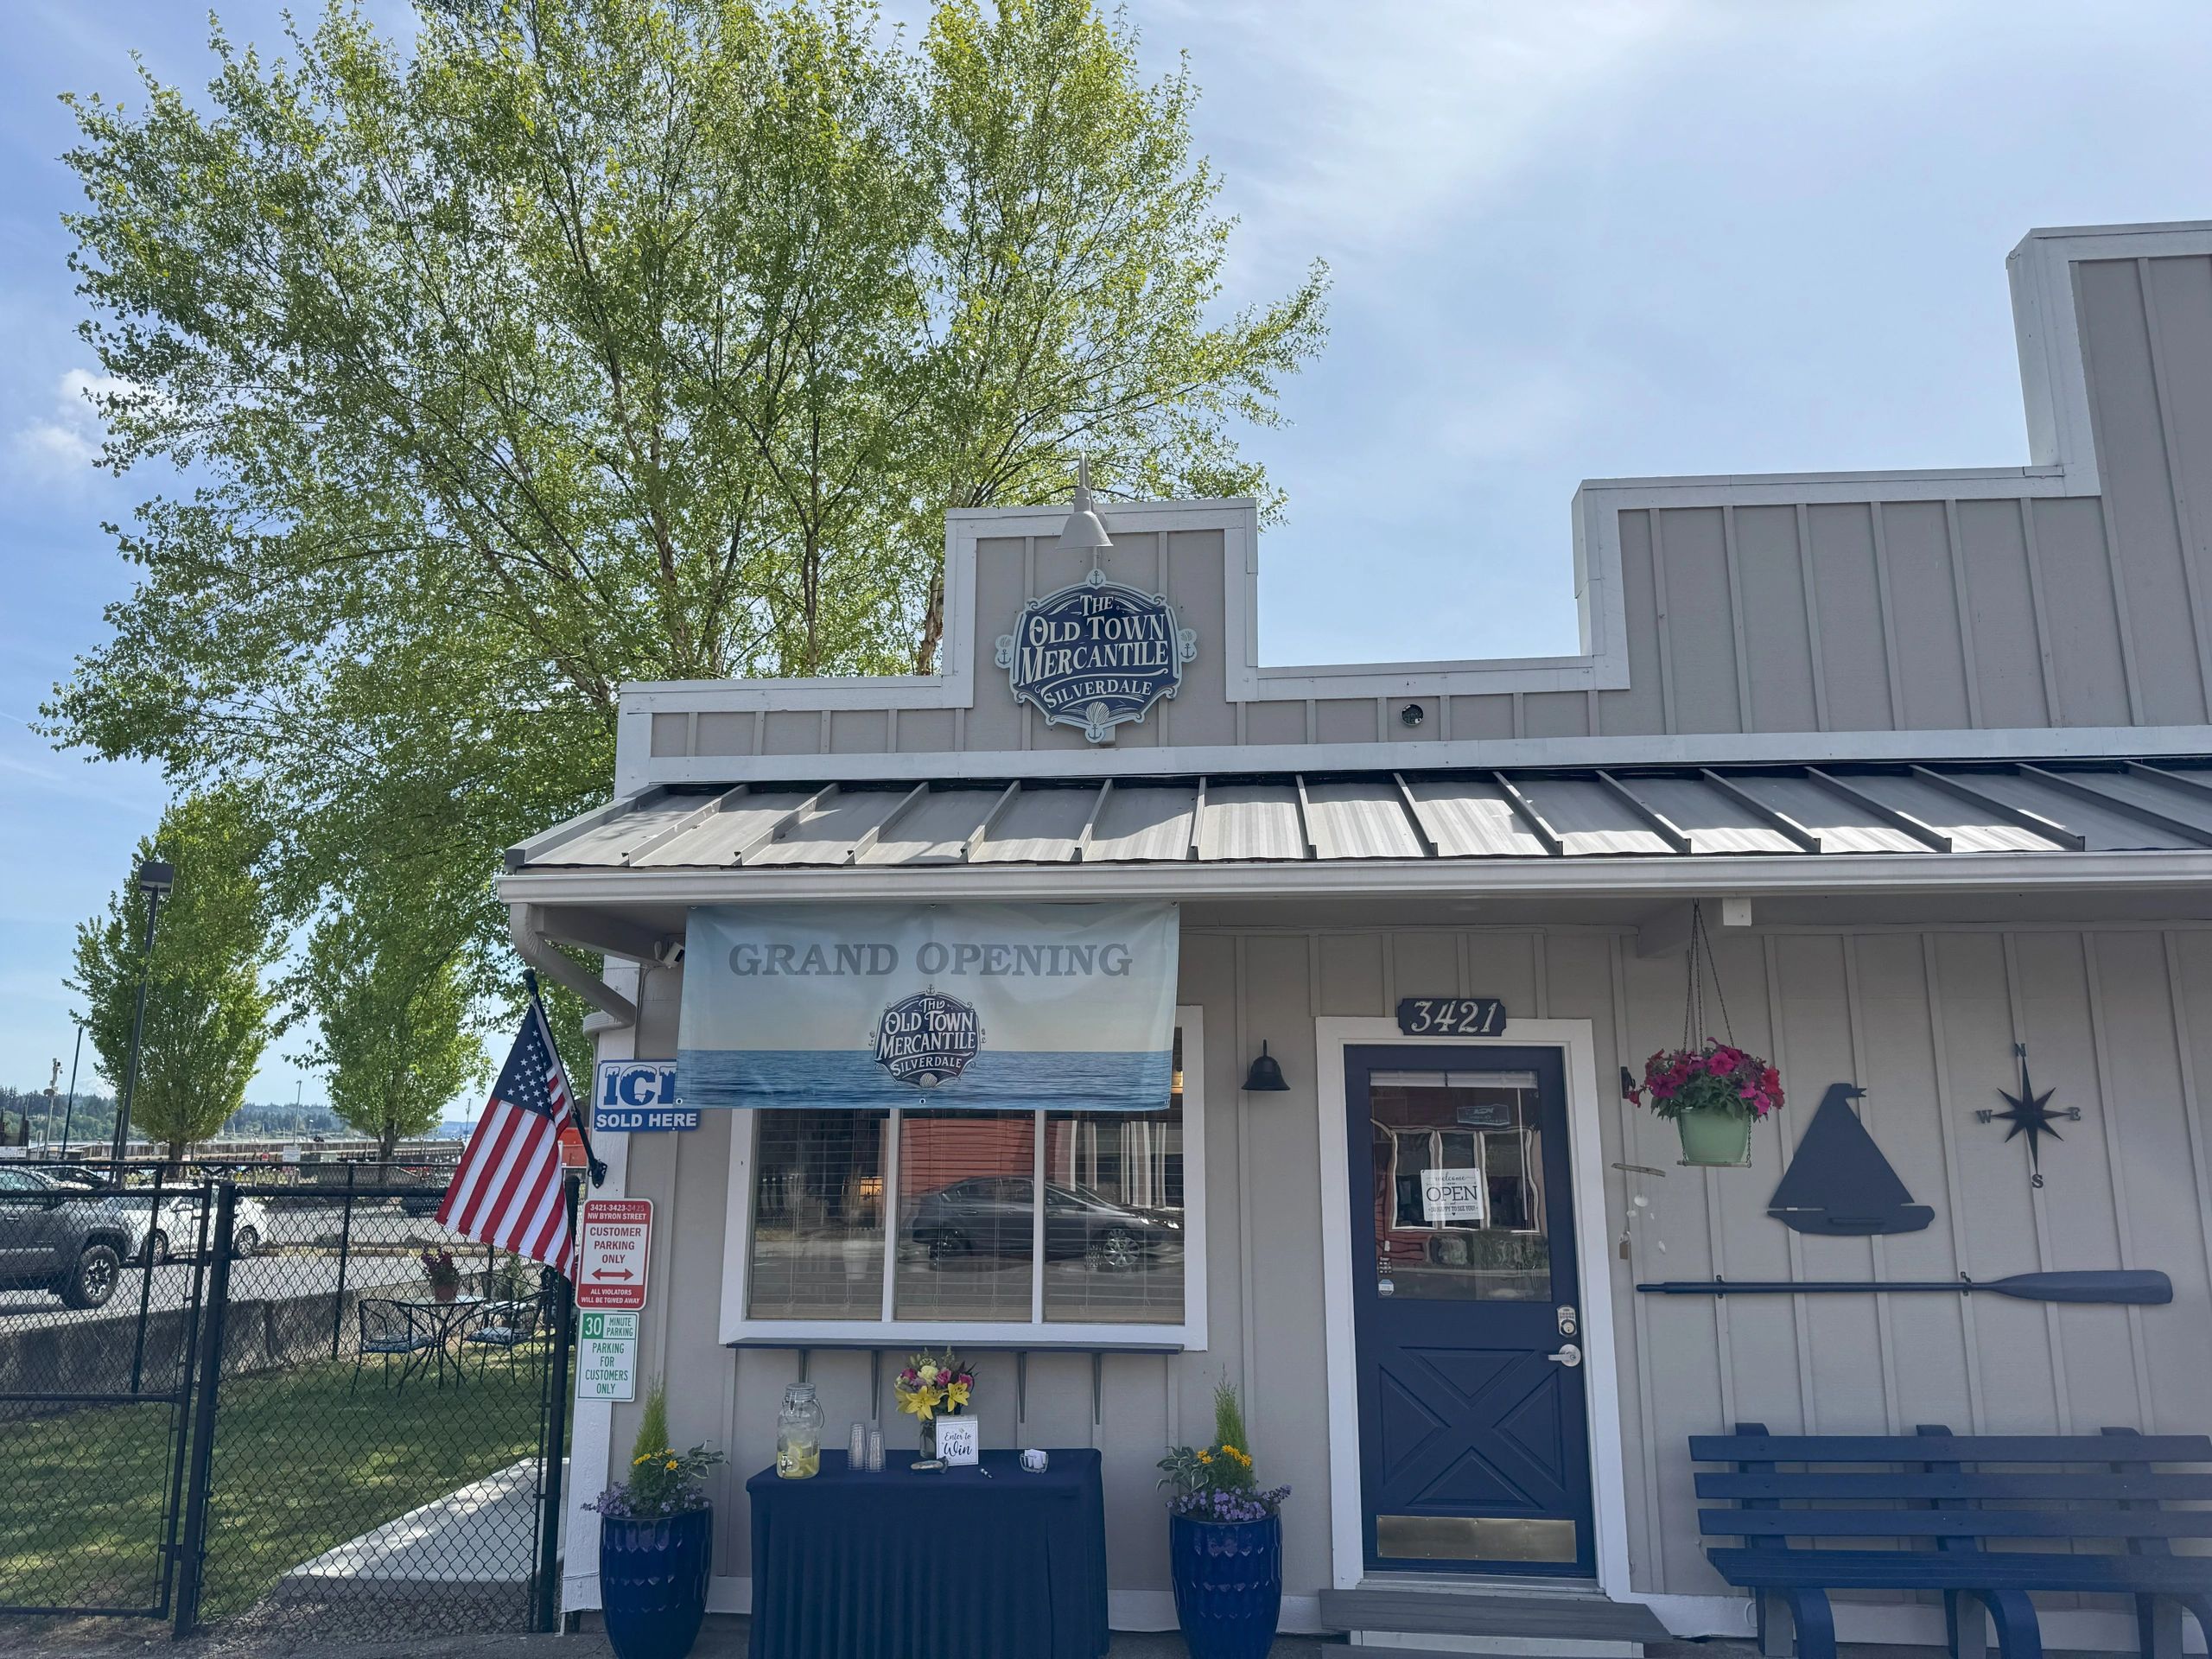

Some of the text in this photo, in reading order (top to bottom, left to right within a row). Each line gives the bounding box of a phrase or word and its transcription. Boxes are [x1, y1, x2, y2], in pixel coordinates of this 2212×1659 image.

[1080, 594, 1114, 617] THE
[1029, 613, 1166, 646] OLD TOWN
[1019, 641, 1168, 687] MERCANTILE
[1042, 679, 1153, 709] SILVERDALE
[728, 942, 1133, 976] GRAND OPENING
[885, 1010, 974, 1035] OLD TOWN
[1410, 1000, 1498, 1033] 3421
[876, 1032, 976, 1060] MERCANTILE
[2015, 1043, 2027, 1058] N
[890, 1056, 963, 1077] SILVERDALE
[596, 1112, 697, 1128] SOLD HERE
[1975, 1107, 2082, 1123] W E
[2031, 1173, 2044, 1189] S
[1426, 1185, 1478, 1202] OPEN
[589, 1227, 641, 1236] CUSTOMER
[594, 1240, 635, 1250] PARKING
[602, 1254, 626, 1264] ONLY
[585, 1317, 632, 1336] 30 MINUTE
[606, 1327, 633, 1337] PARKING
[592, 1342, 625, 1354] PARKING
[600, 1356, 615, 1367] FOR
[585, 1369, 629, 1382] CUSTOMERS
[596, 1382, 616, 1395] ONLY
[944, 1431, 972, 1441] Enter to
[944, 1440, 973, 1457] Win
